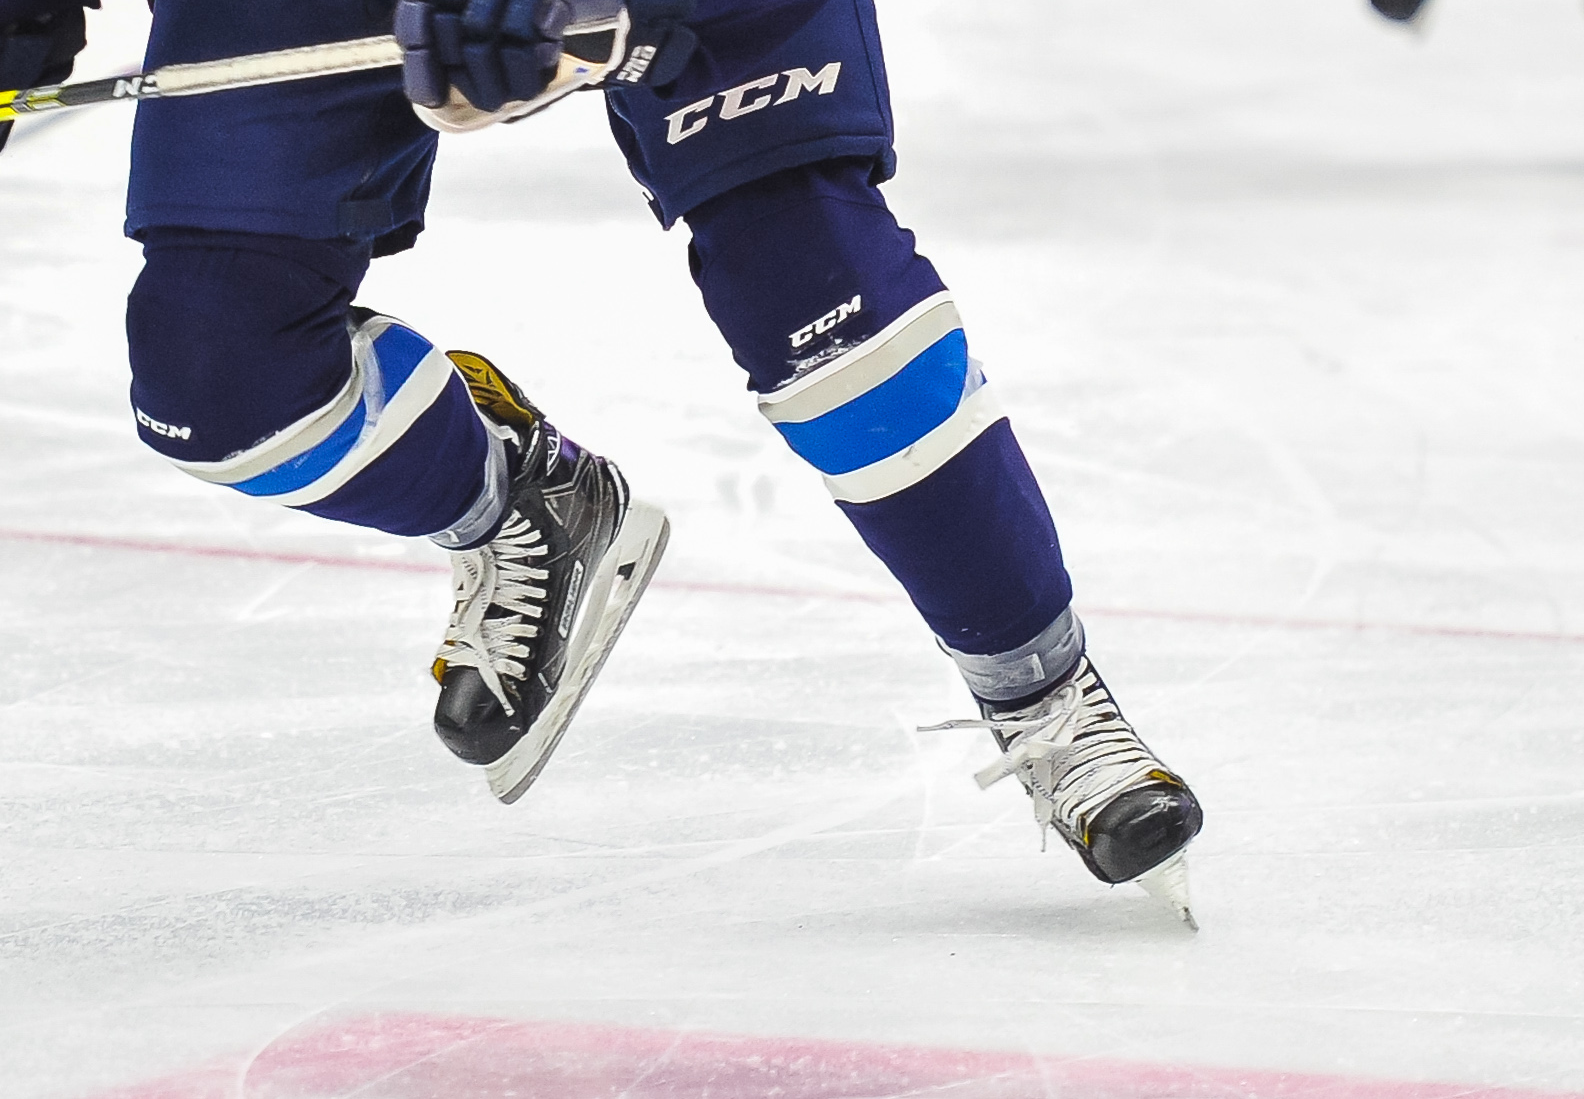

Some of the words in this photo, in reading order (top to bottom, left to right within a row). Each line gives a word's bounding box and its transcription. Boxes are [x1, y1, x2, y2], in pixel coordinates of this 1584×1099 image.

[664, 62, 842, 145] CCM
[788, 294, 862, 348] CCM
[136, 406, 192, 440] CCM
